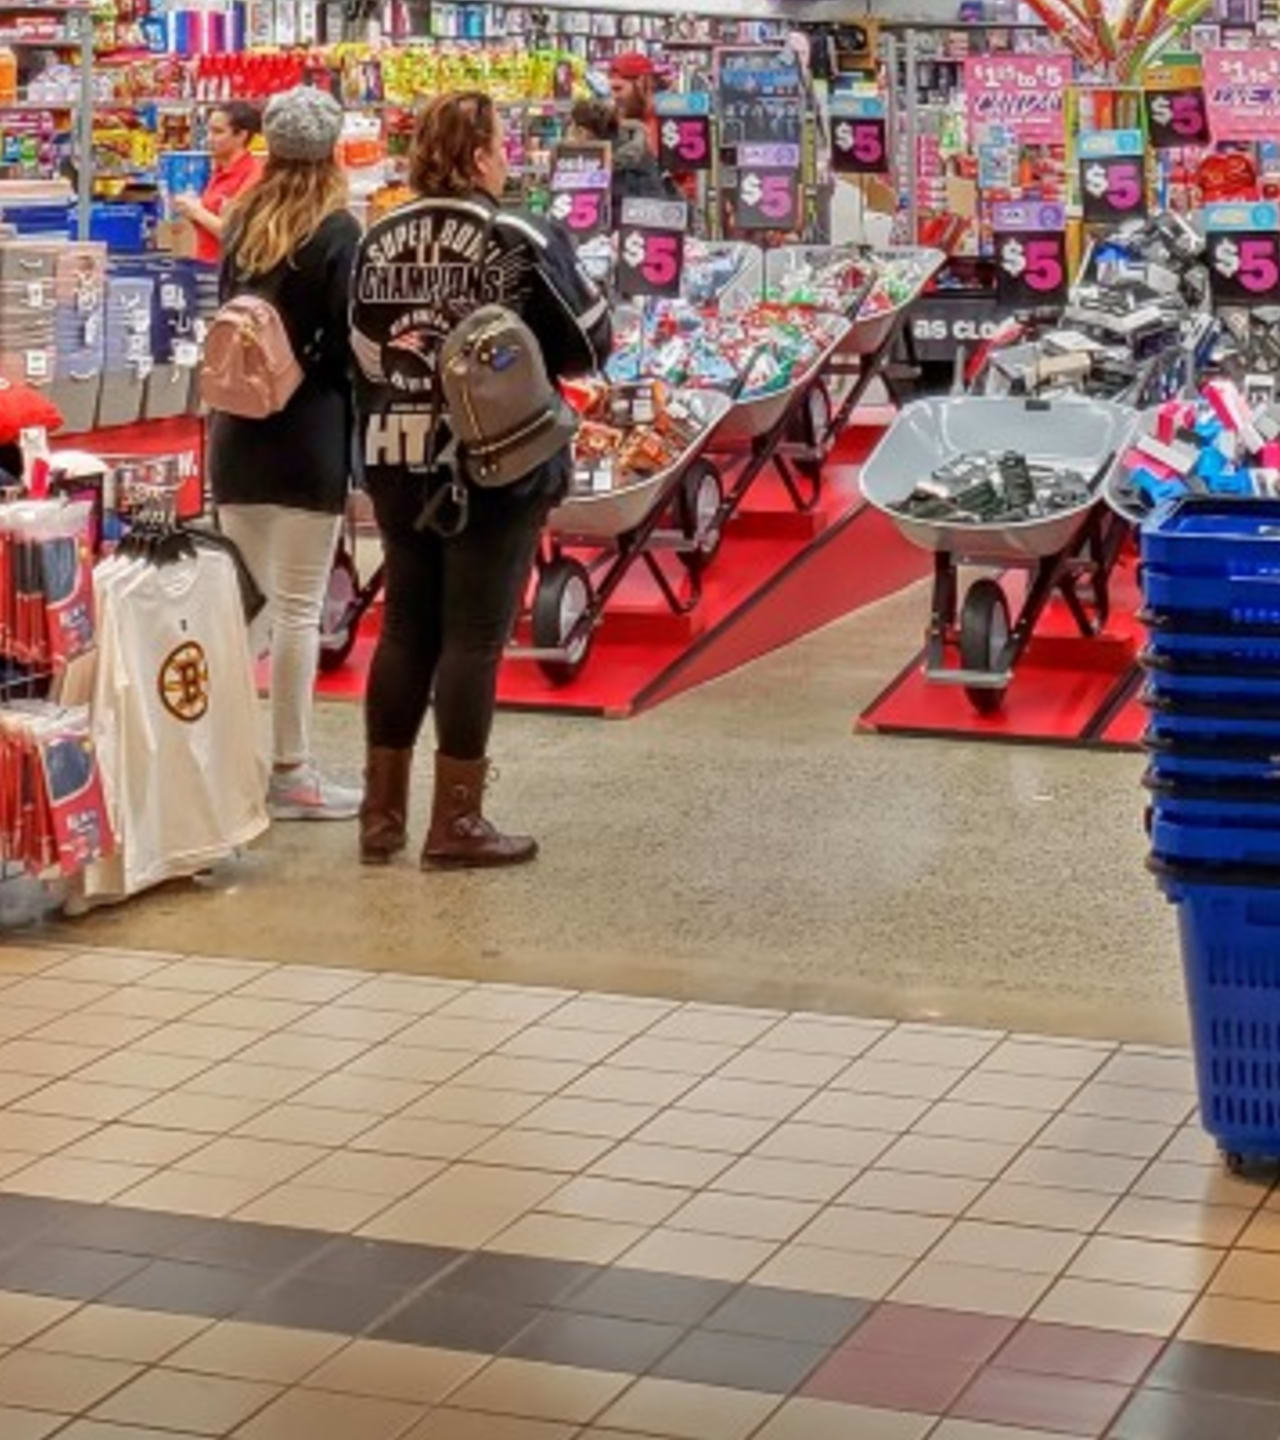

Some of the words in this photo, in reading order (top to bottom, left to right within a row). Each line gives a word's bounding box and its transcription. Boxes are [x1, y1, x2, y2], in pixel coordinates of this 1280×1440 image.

[1150, 95, 1203, 135] $5
[662, 121, 707, 161] $5
[835, 121, 882, 163] $5
[741, 173, 793, 219] $5
[1085, 163, 1141, 209] $5
[551, 191, 601, 229] $5
[368, 216, 433, 268] SUPER
[624, 230, 678, 285] $5
[1001, 238, 1063, 291] $5
[1214, 238, 1279, 292] $5
